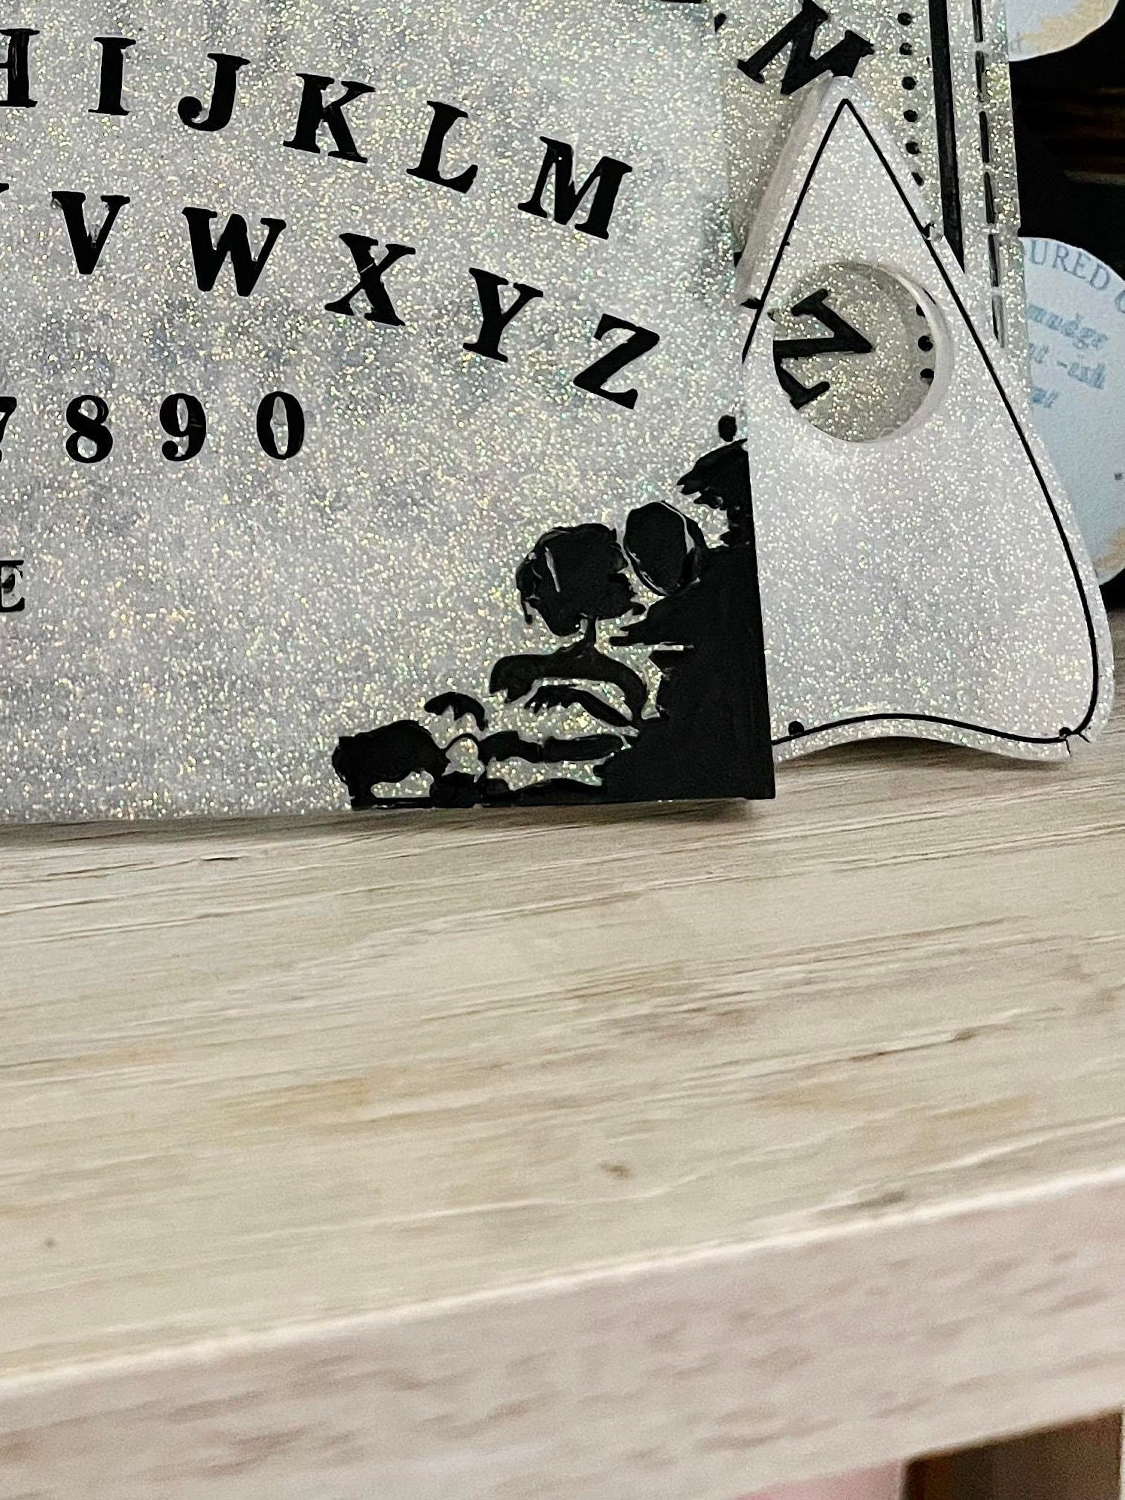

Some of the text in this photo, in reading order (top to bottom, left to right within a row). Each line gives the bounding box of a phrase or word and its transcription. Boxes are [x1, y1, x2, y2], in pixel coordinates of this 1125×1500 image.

[88, 36, 137, 116] I
[177, 52, 251, 132] J
[282, 73, 376, 164] K
[406, 100, 479, 194] L
[517, 136, 633, 240] M
[51, 190, 131, 275] V
[181, 207, 287, 298] W
[324, 232, 416, 327] X
[463, 267, 544, 363] Y
[573, 313, 660, 410] Z
[65, 394, 114, 464] 8
[159, 392, 207, 462] 9
[256, 390, 305, 461] 0
